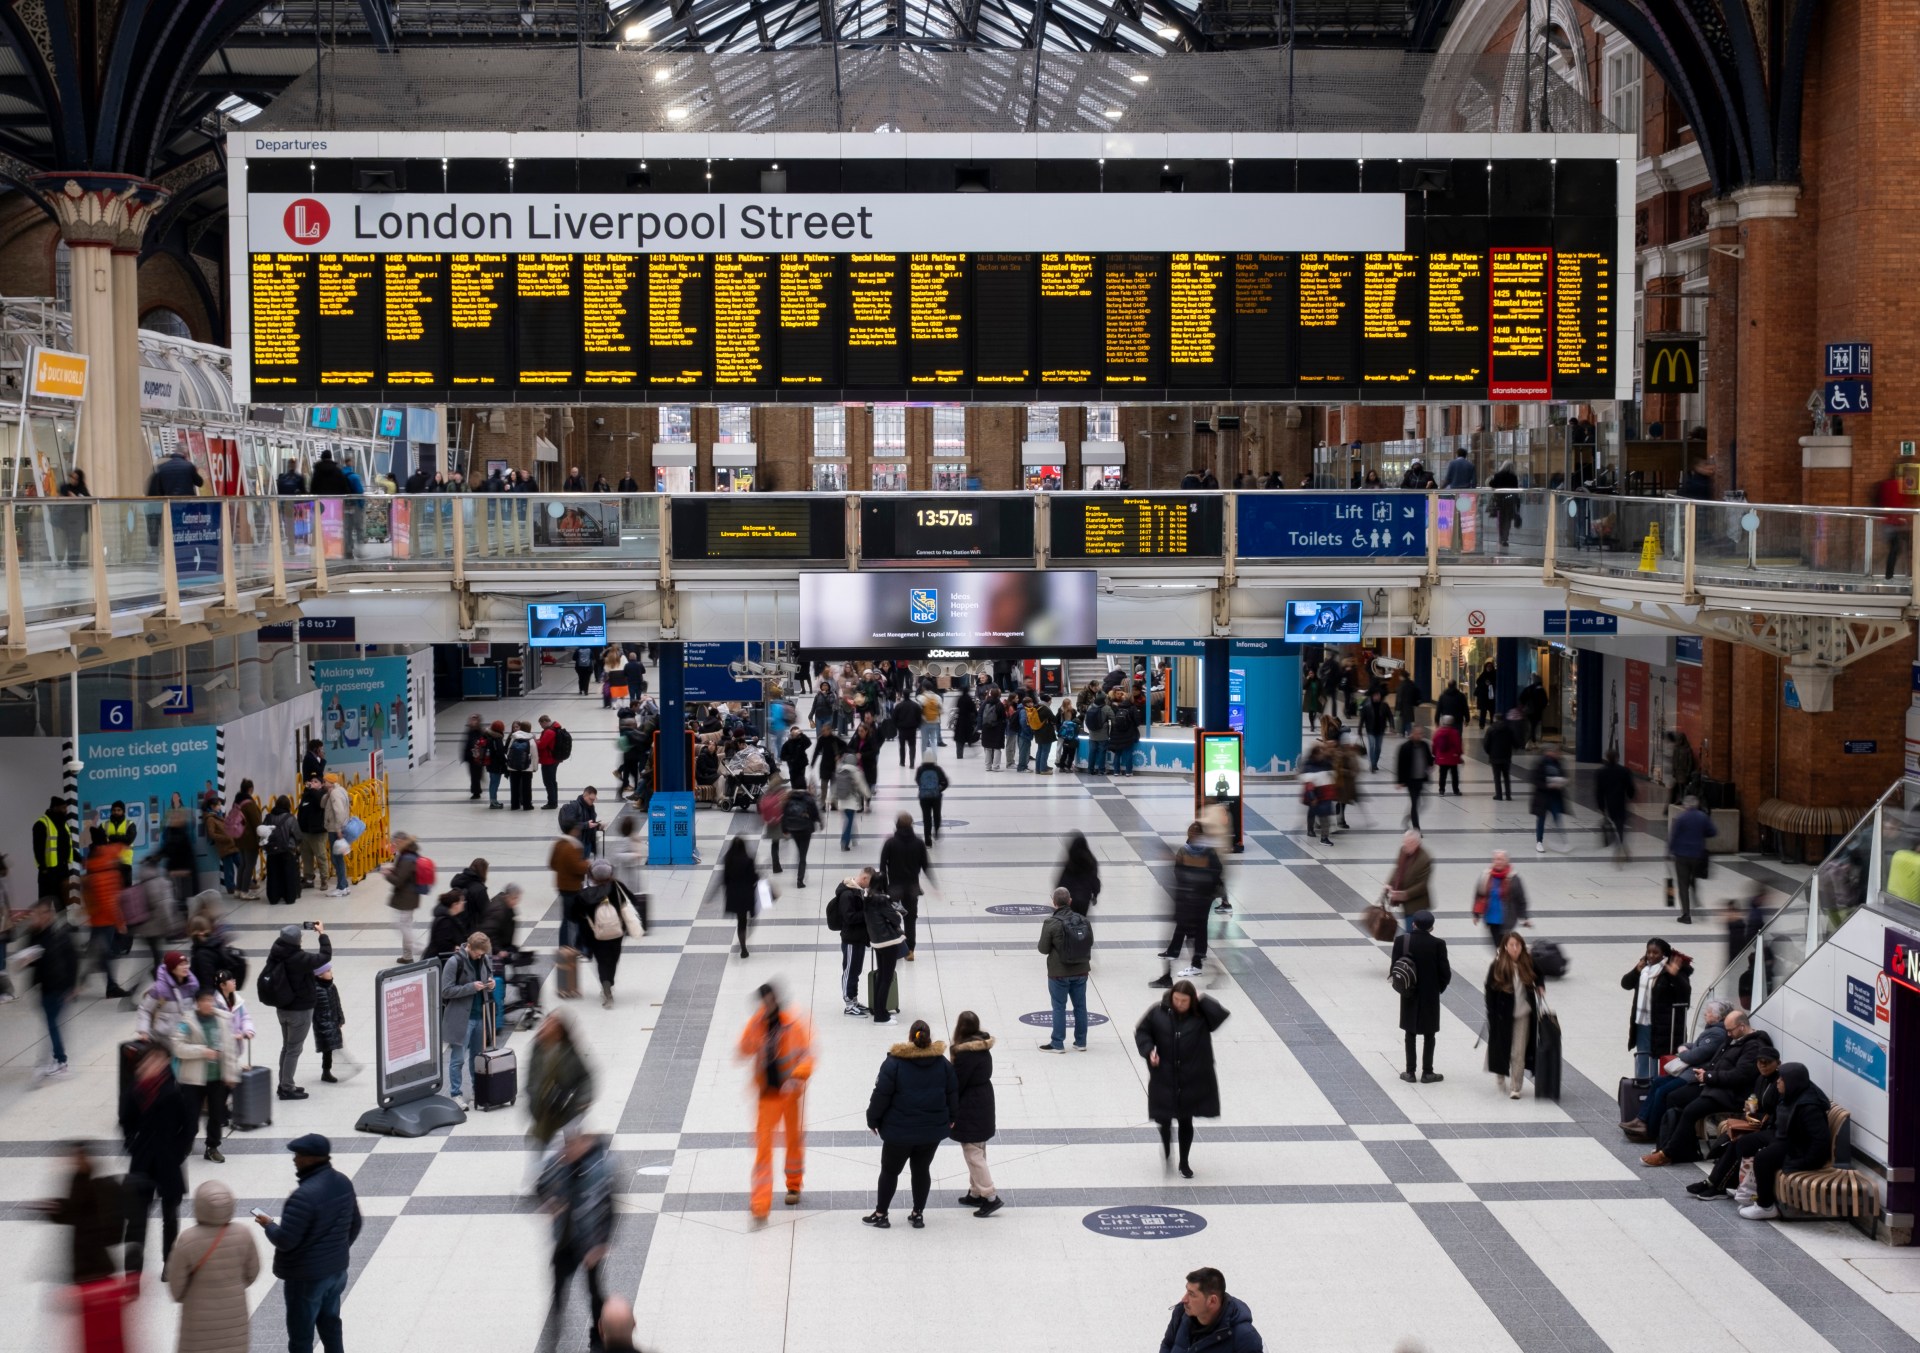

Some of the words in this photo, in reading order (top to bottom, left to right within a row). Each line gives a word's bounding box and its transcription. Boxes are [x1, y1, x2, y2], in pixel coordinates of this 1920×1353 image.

[255, 139, 327, 152] Departures
[355, 203, 512, 239] London
[528, 203, 725, 248] Liverpool
[740, 205, 873, 239] Street
[277, 254, 304, 262] Platform
[342, 254, 368, 262] Platform
[406, 254, 433, 262] Platform
[474, 254, 501, 262] Platform
[540, 254, 567, 262] Platform
[670, 254, 696, 262] Platform
[851, 254, 872, 262] Special
[874, 254, 896, 262] Notices
[931, 254, 957, 262] Platform
[144, 380, 172, 399] supercuts
[1336, 505, 1363, 519] Lift
[1288, 531, 1342, 545] Toilets
[950, 602, 979, 610] Happen
[950, 610, 968, 618] Here
[927, 650, 969, 658] JCDecaux
[321, 668, 354, 678] Making
[356, 667, 374, 677] way
[321, 682, 333, 692] for
[336, 681, 385, 693] passengers
[172, 691, 183, 706] 7
[110, 706, 123, 724] 6
[89, 745, 125, 759] More
[129, 741, 168, 756] ticket
[171, 739, 208, 756] gates
[89, 765, 140, 780] coming
[144, 763, 177, 775] soon
[387, 990, 402, 999] Ticket
[402, 985, 416, 994] office
